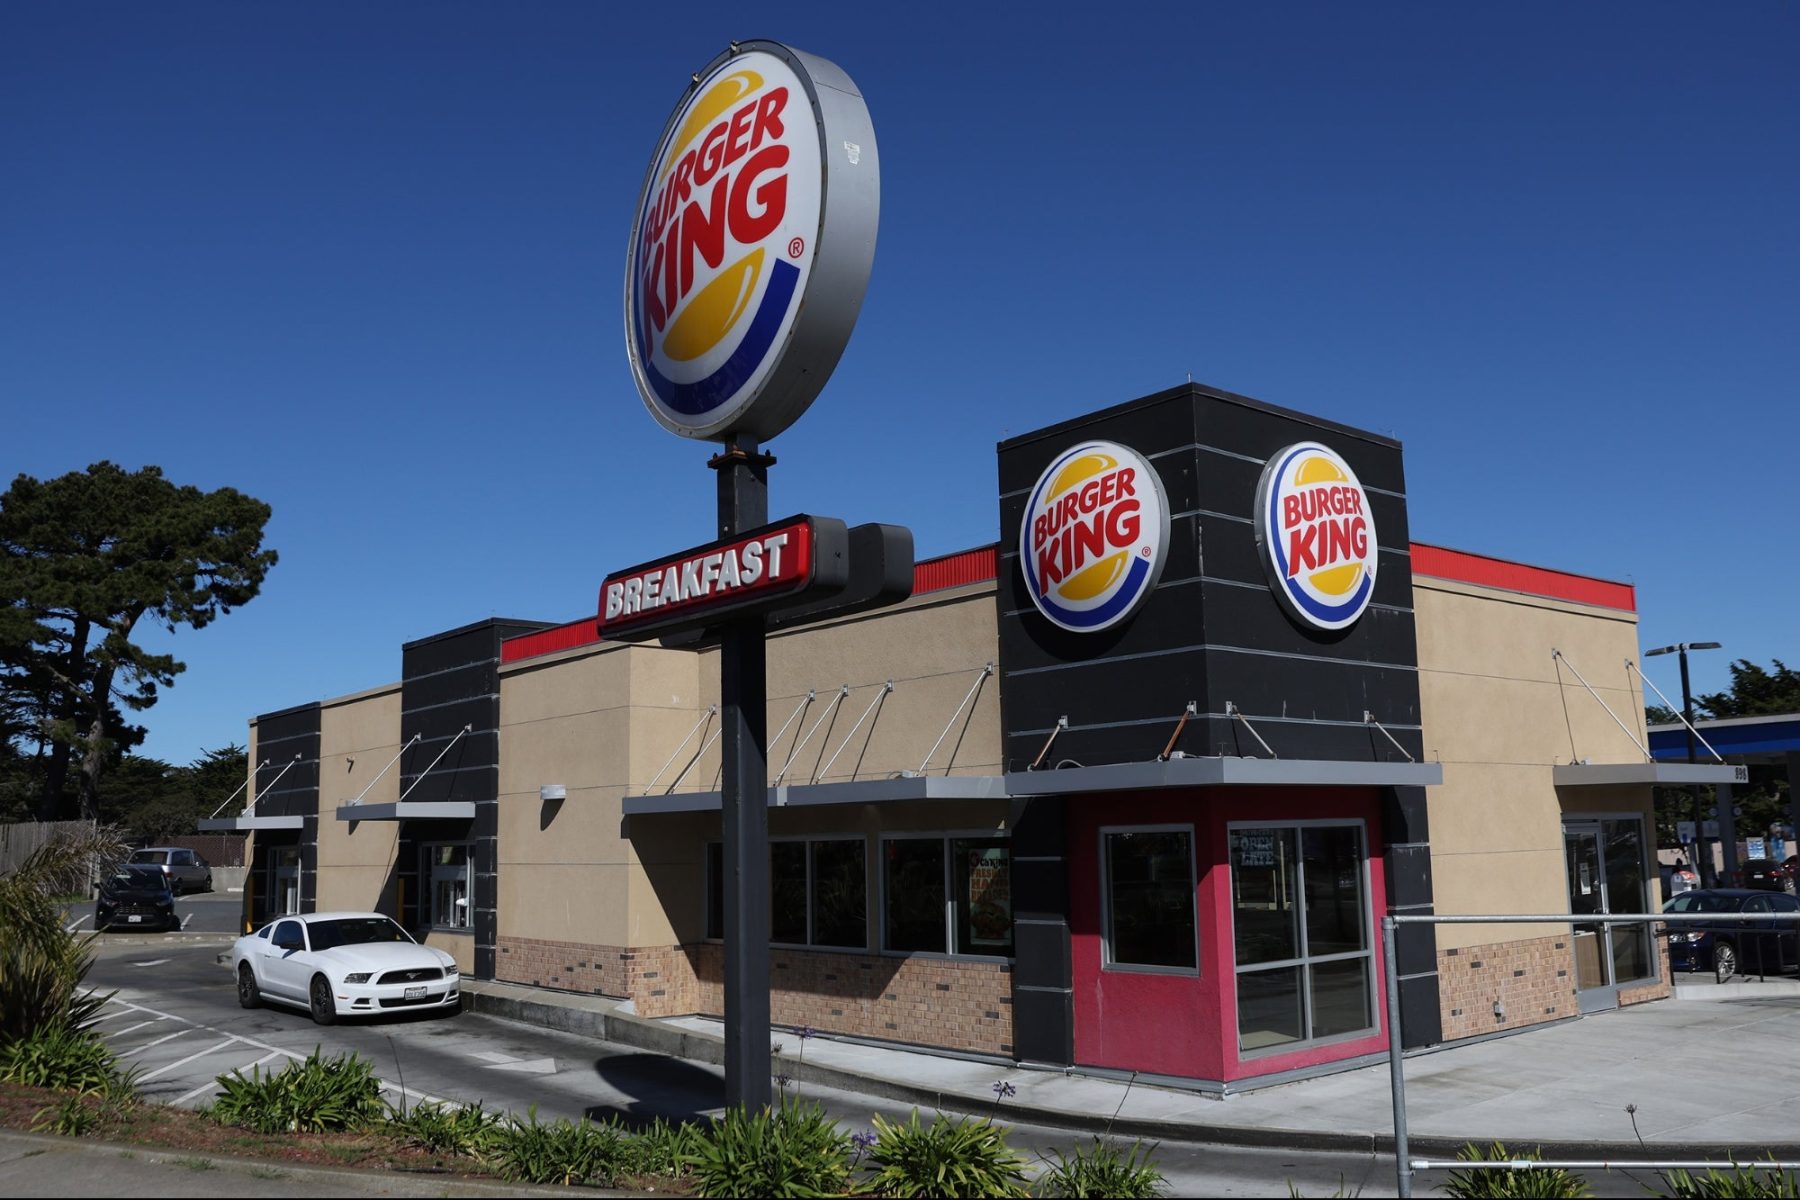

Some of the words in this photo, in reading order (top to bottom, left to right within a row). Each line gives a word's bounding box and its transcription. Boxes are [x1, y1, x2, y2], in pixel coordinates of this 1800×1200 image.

[642, 86, 789, 271] BURGER
[643, 144, 790, 367] KING
[1034, 467, 1136, 552] BURGER
[1037, 498, 1141, 597] KING
[1283, 486, 1363, 530] BURGER
[1288, 516, 1367, 577] KING
[605, 533, 788, 621] BREAKFAST
